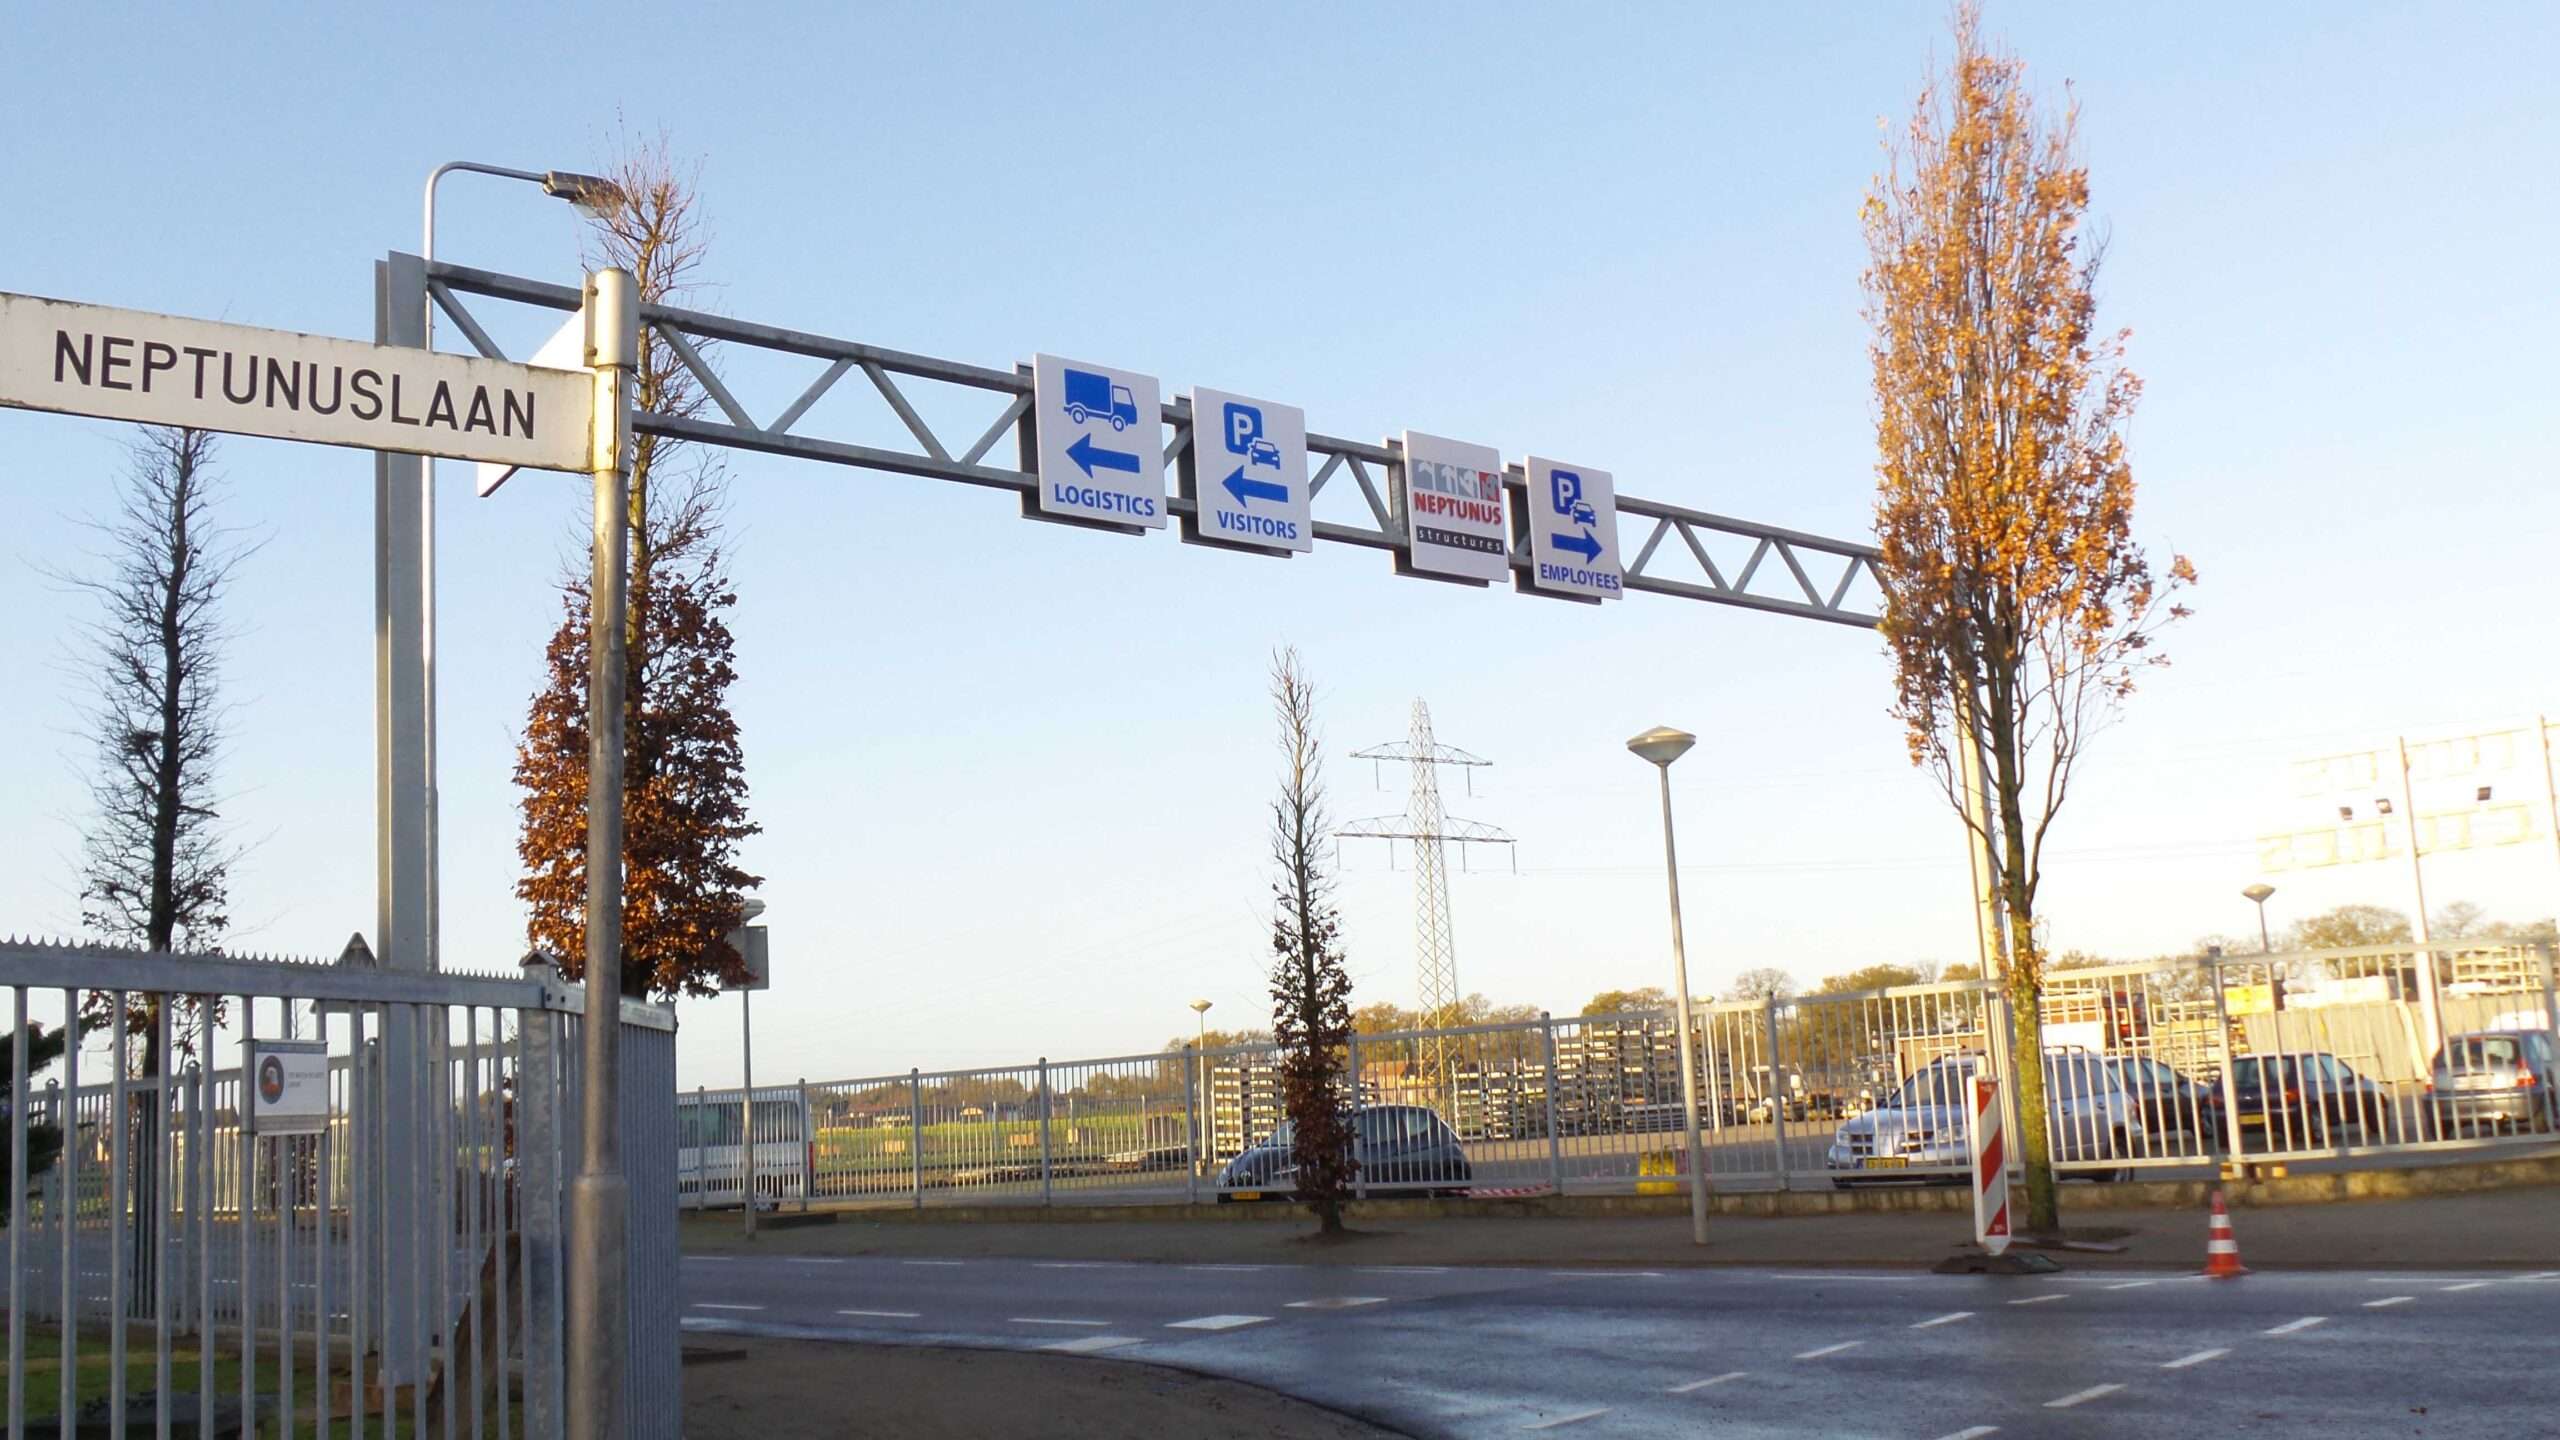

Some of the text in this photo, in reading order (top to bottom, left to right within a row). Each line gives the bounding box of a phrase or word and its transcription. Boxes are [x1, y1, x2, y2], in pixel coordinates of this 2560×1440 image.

[54, 329, 536, 440] NEPTUNUSLAAN
[1232, 411, 1254, 447] P
[1054, 483, 1155, 517] LOGISTICS
[1413, 491, 1502, 526] NEPTUNUS
[1557, 477, 1575, 508] P
[1216, 509, 1298, 540] VISITORS
[1418, 528, 1501, 552] structures
[1540, 562, 1620, 591] EMPLOYEES
